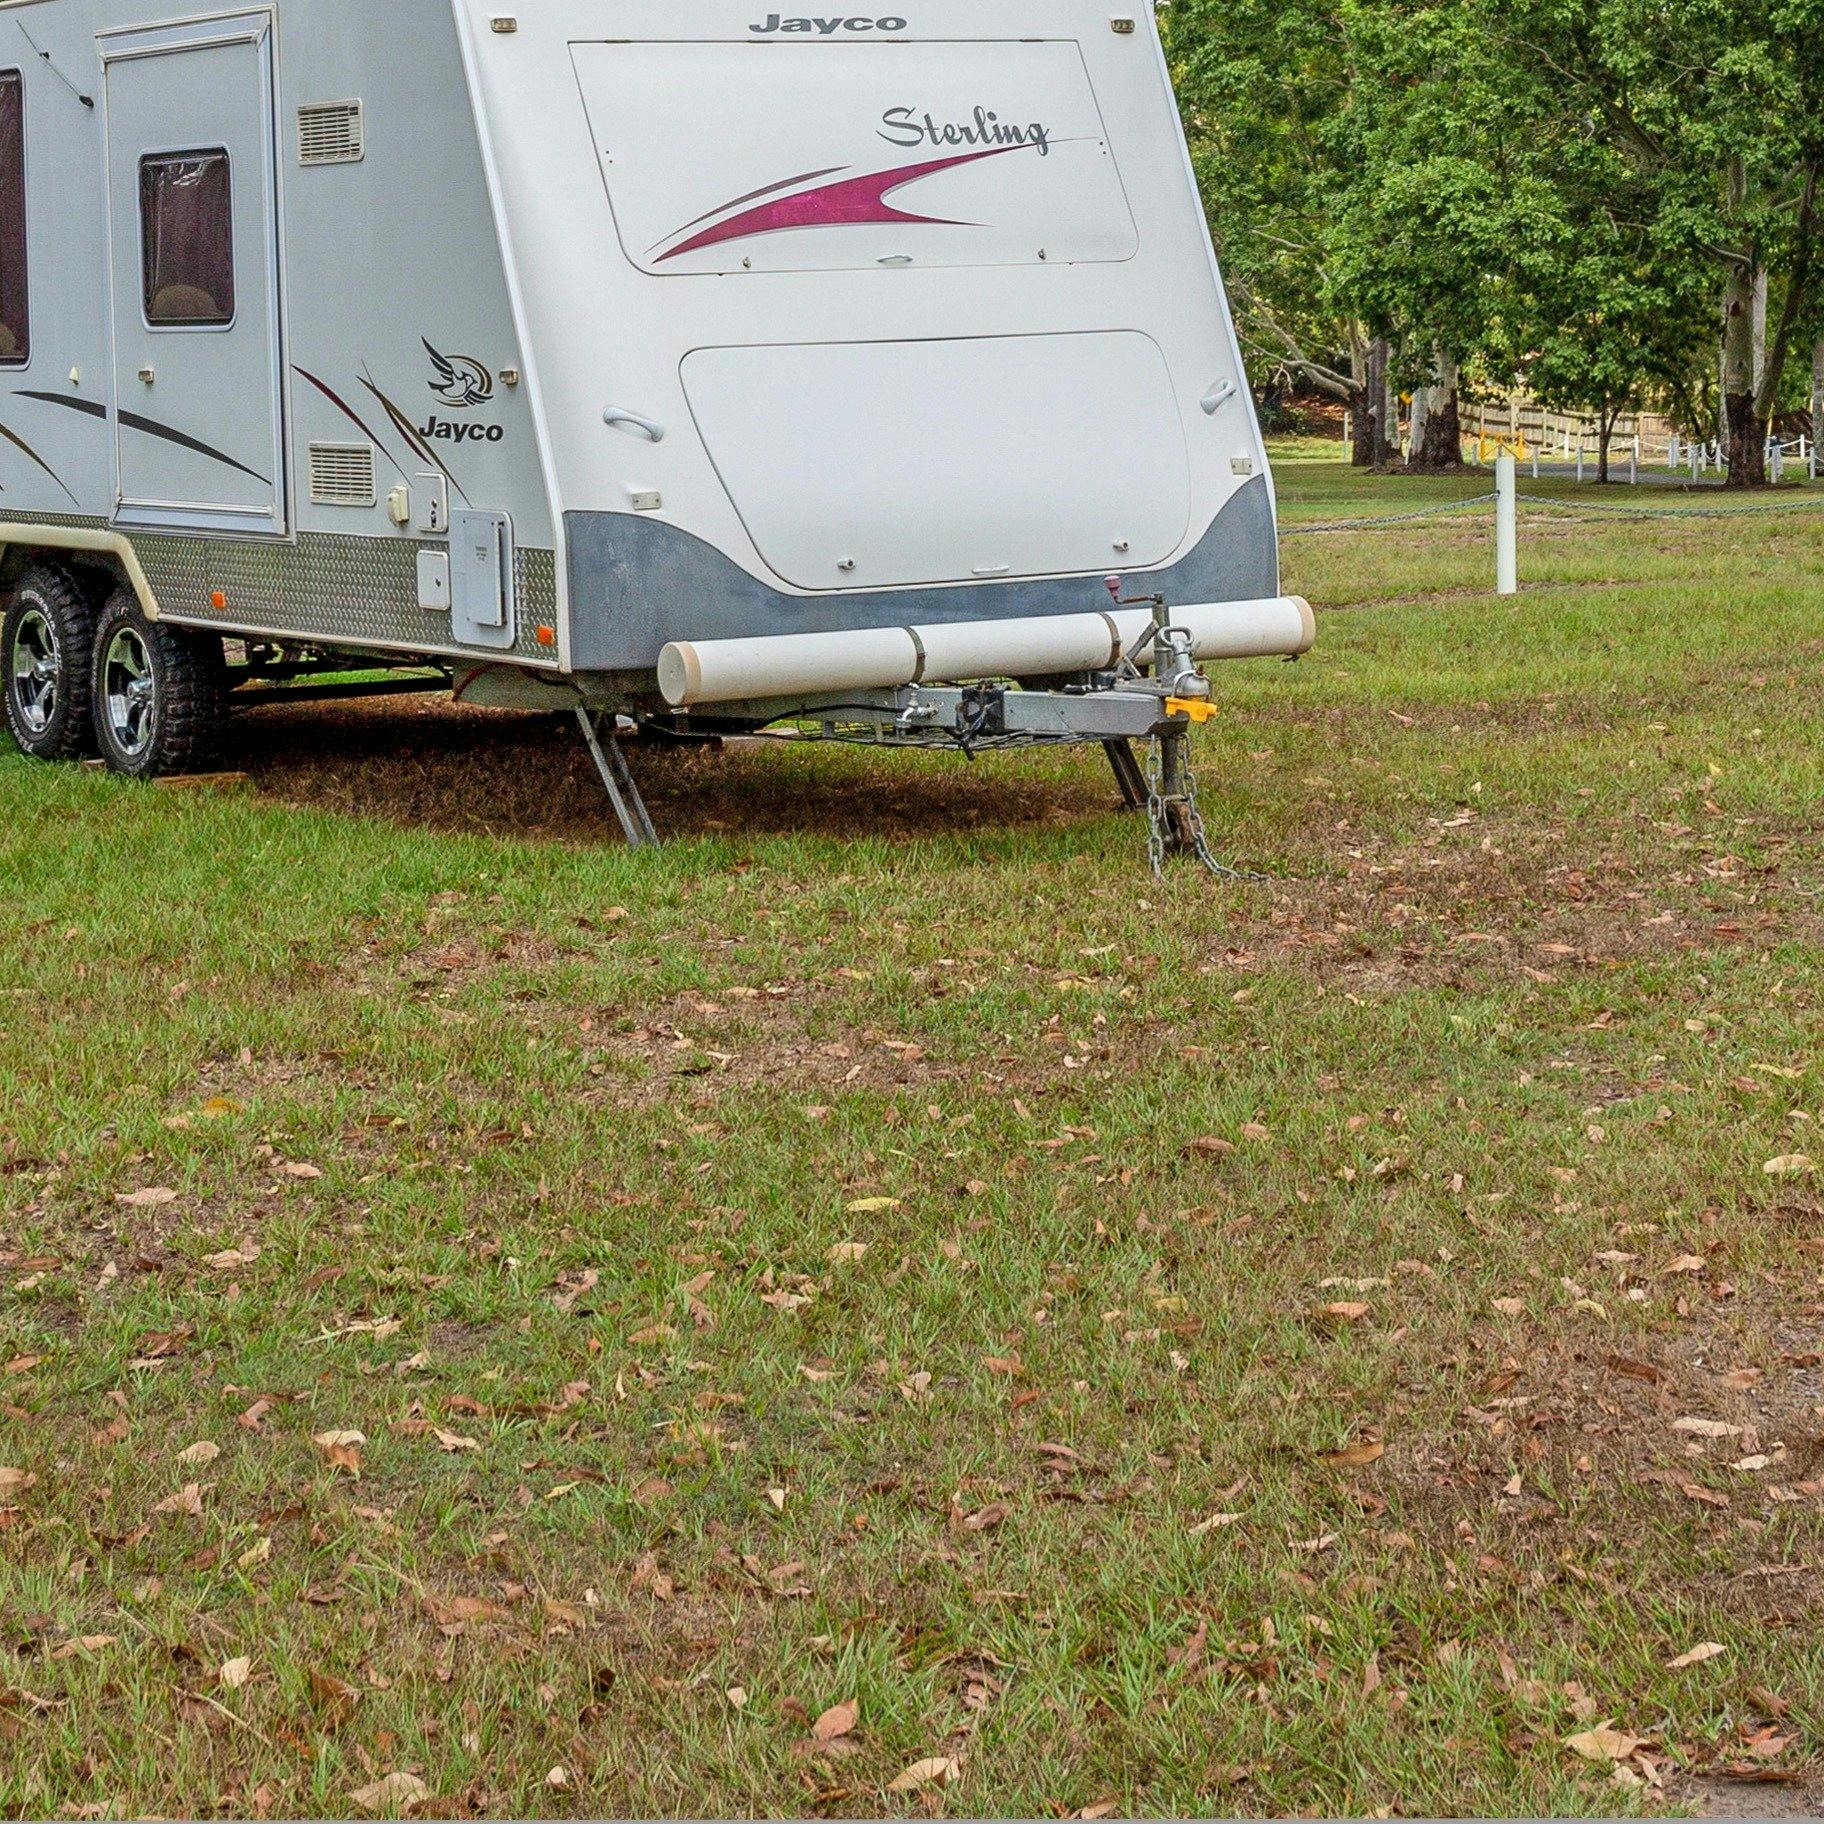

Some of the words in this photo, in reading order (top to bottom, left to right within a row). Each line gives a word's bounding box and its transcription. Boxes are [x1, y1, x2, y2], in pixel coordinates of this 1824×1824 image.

[748, 13, 907, 34] Jayco
[876, 105, 1050, 157] Sterling
[418, 416, 504, 443] Jayco
